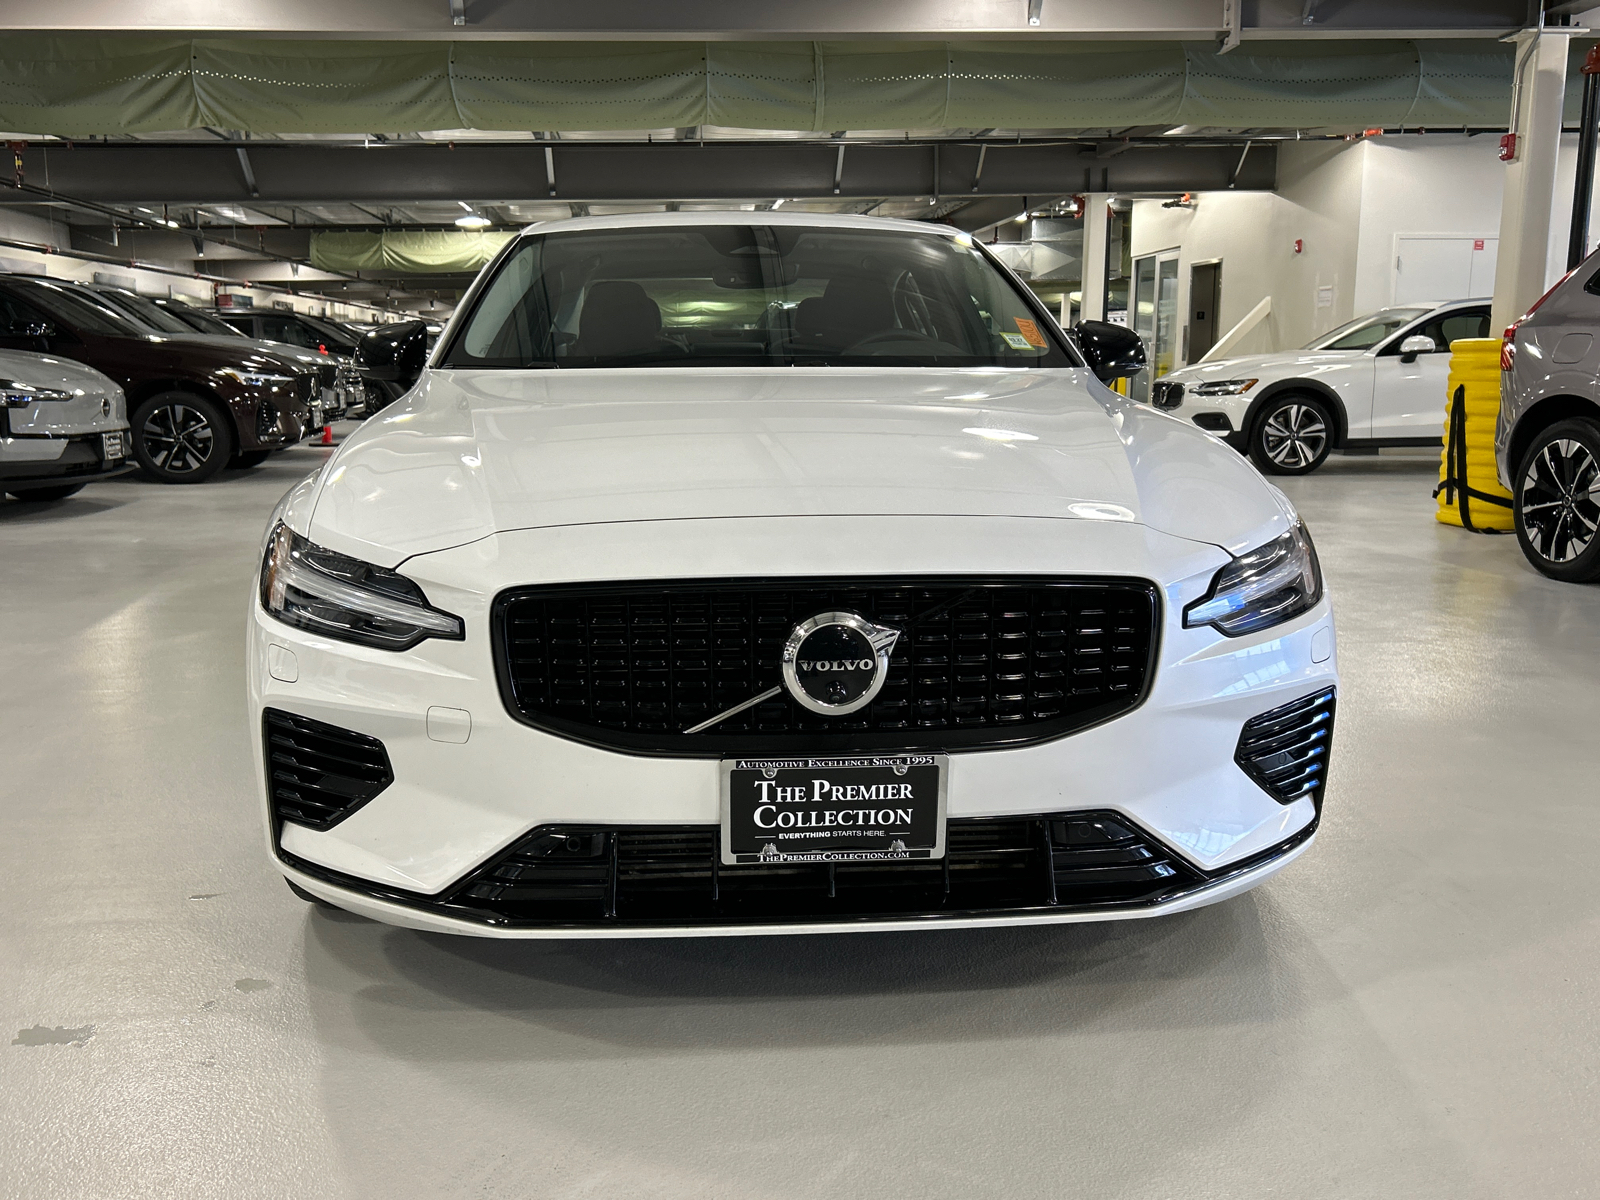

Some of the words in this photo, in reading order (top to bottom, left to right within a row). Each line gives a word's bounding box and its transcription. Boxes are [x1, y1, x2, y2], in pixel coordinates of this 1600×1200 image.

[798, 659, 874, 671] VOLVO
[906, 756, 933, 765] 1995
[754, 780, 807, 803] THE
[811, 779, 914, 801] PREMIER
[753, 805, 914, 828] COLLECTION
[778, 831, 831, 840] EVERYTHING
[832, 830, 862, 838] STARTS
